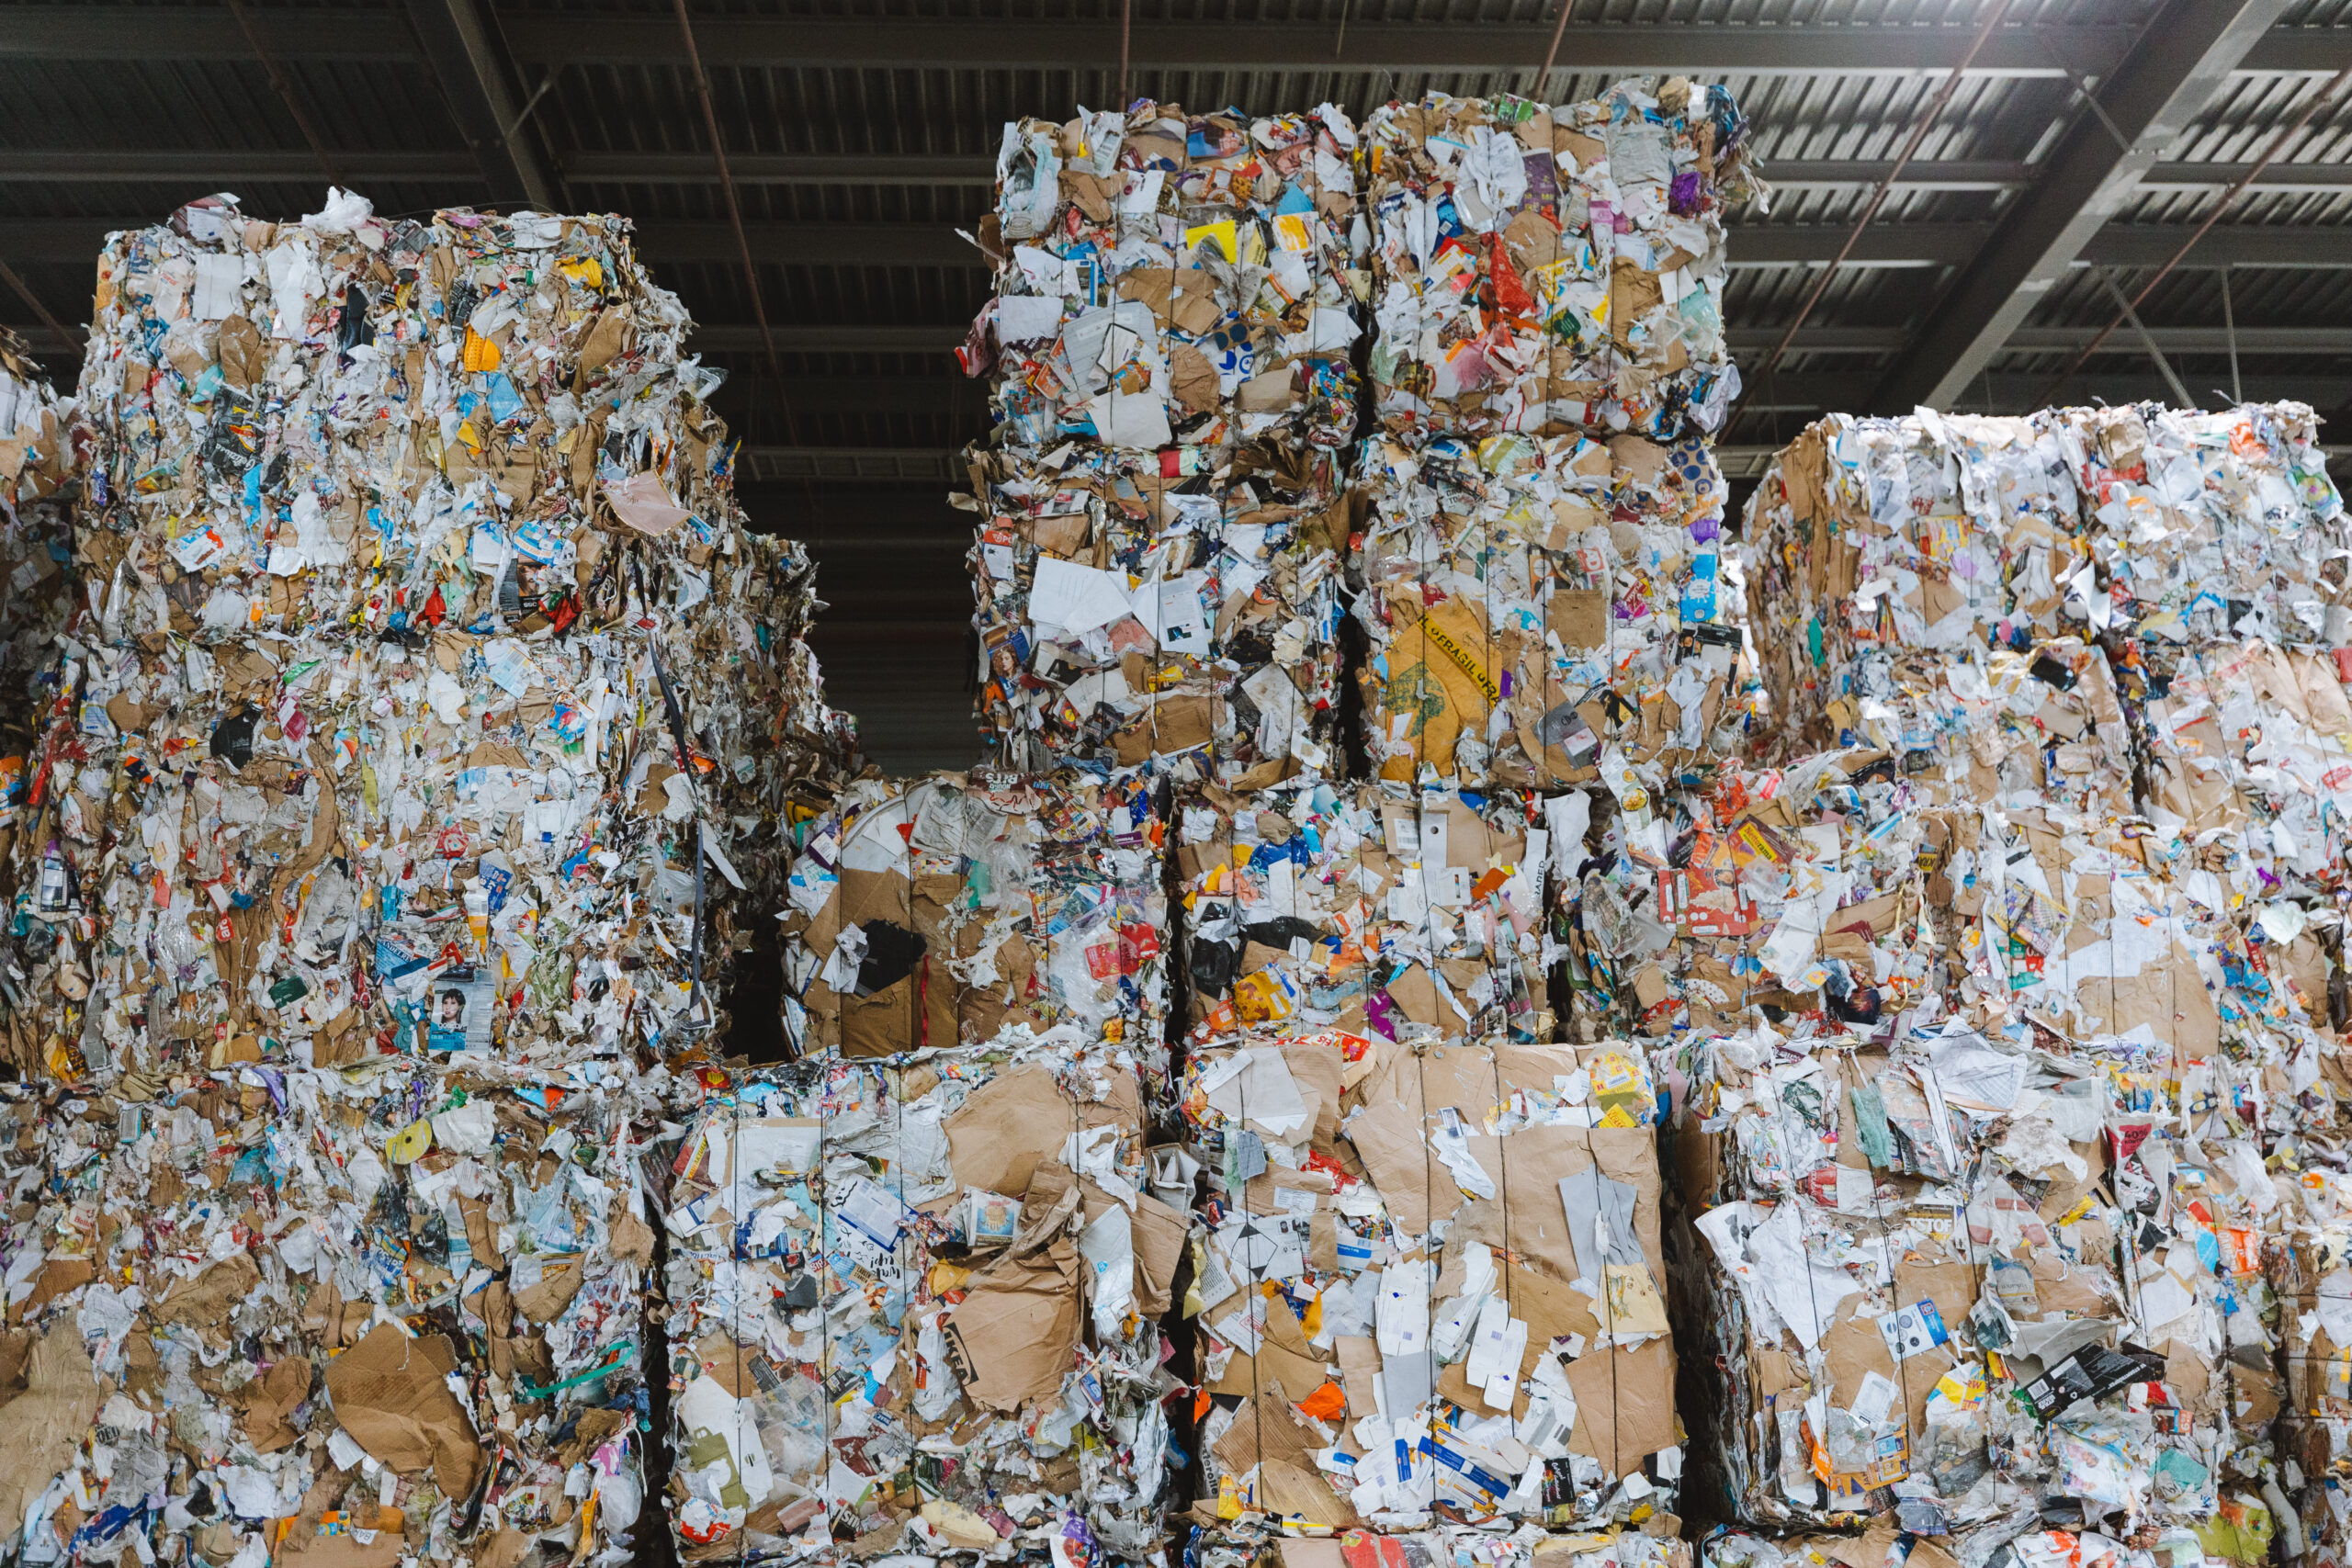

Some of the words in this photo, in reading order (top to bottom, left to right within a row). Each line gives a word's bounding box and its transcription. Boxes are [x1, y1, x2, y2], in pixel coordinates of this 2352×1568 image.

[1436, 634, 1476, 677] FRAGIL
[1740, 823, 1778, 863] Nettorama
[944, 1331, 970, 1383] IKEA
